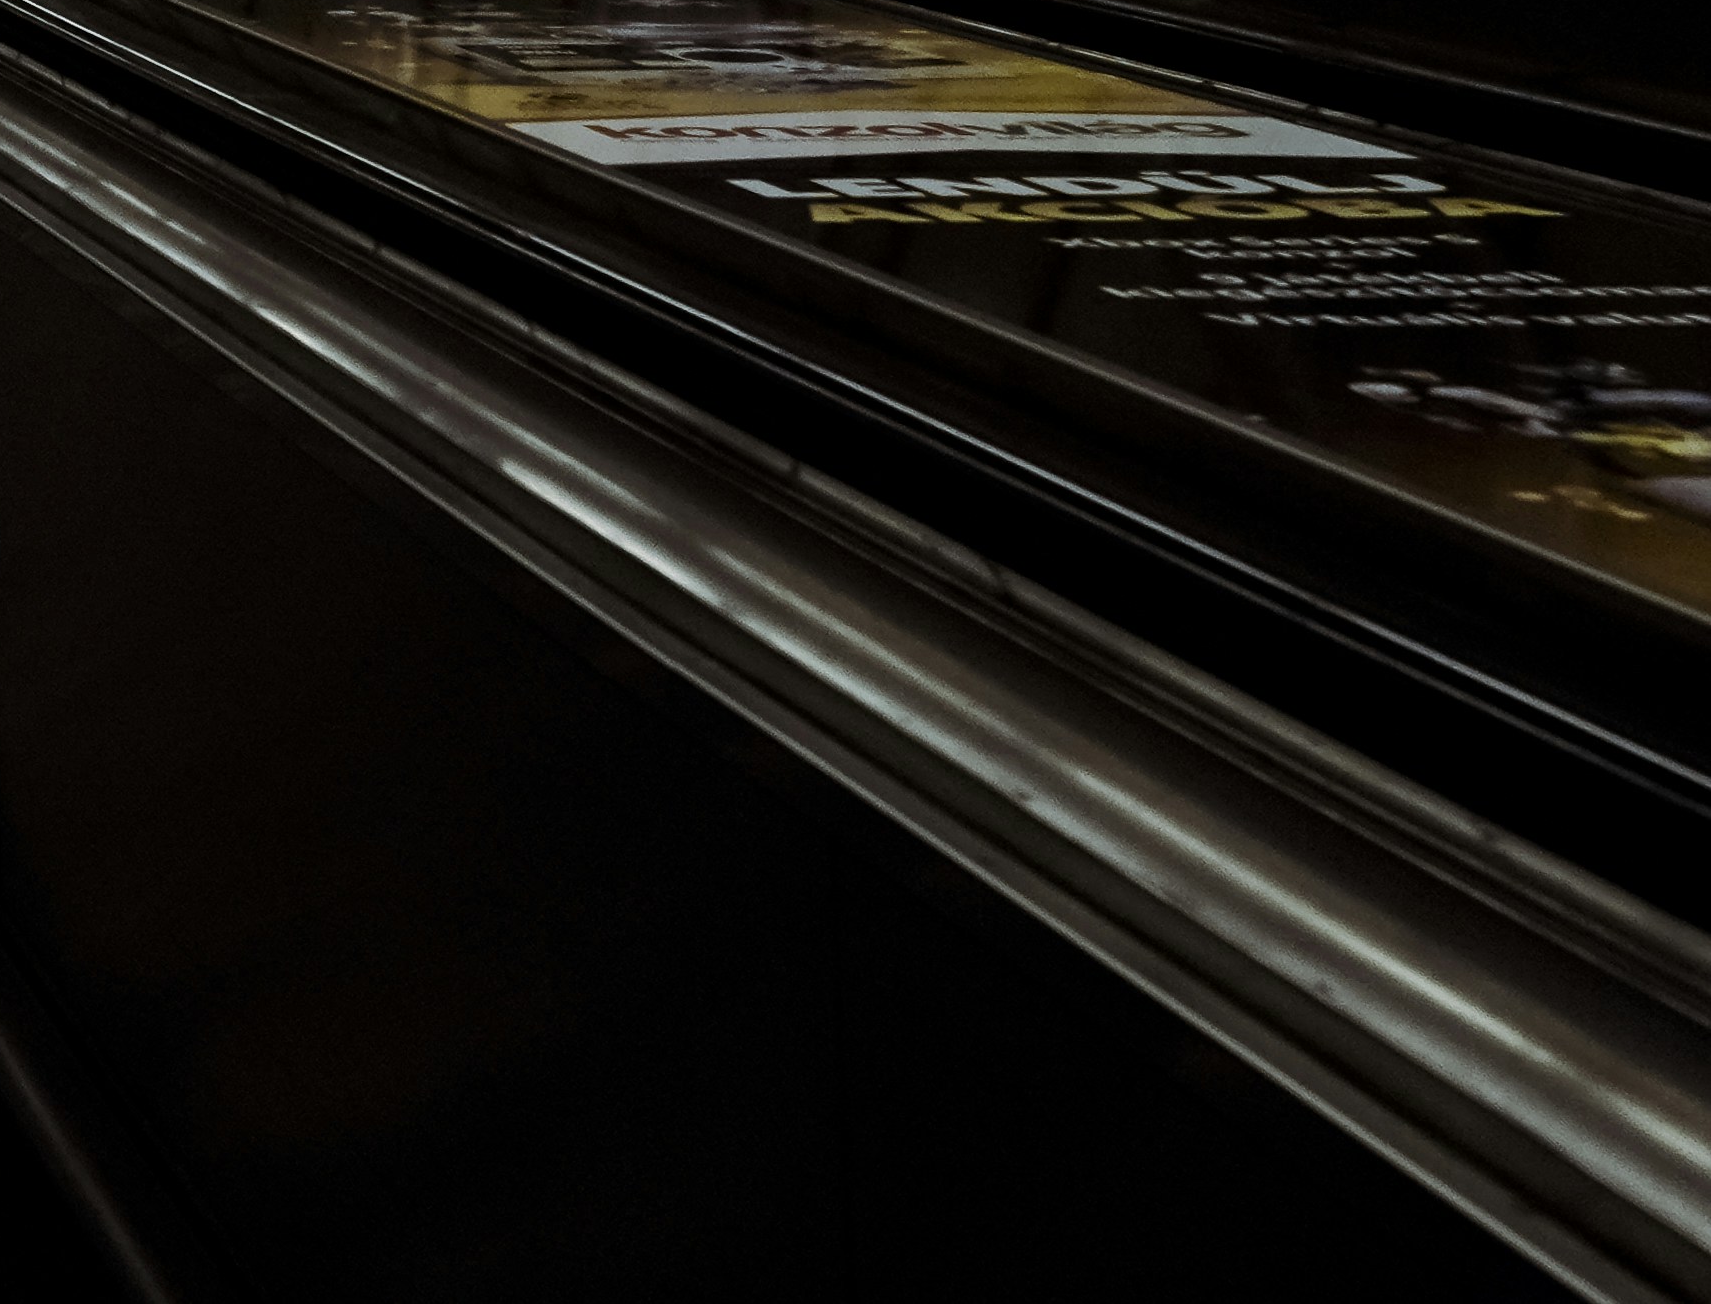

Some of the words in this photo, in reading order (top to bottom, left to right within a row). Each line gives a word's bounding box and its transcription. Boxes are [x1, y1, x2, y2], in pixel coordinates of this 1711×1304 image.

[582, 119, 1249, 139] konzolvilág
[725, 170, 1448, 199] LENDÜLJ
[807, 194, 1568, 224] AKCIÓBA
